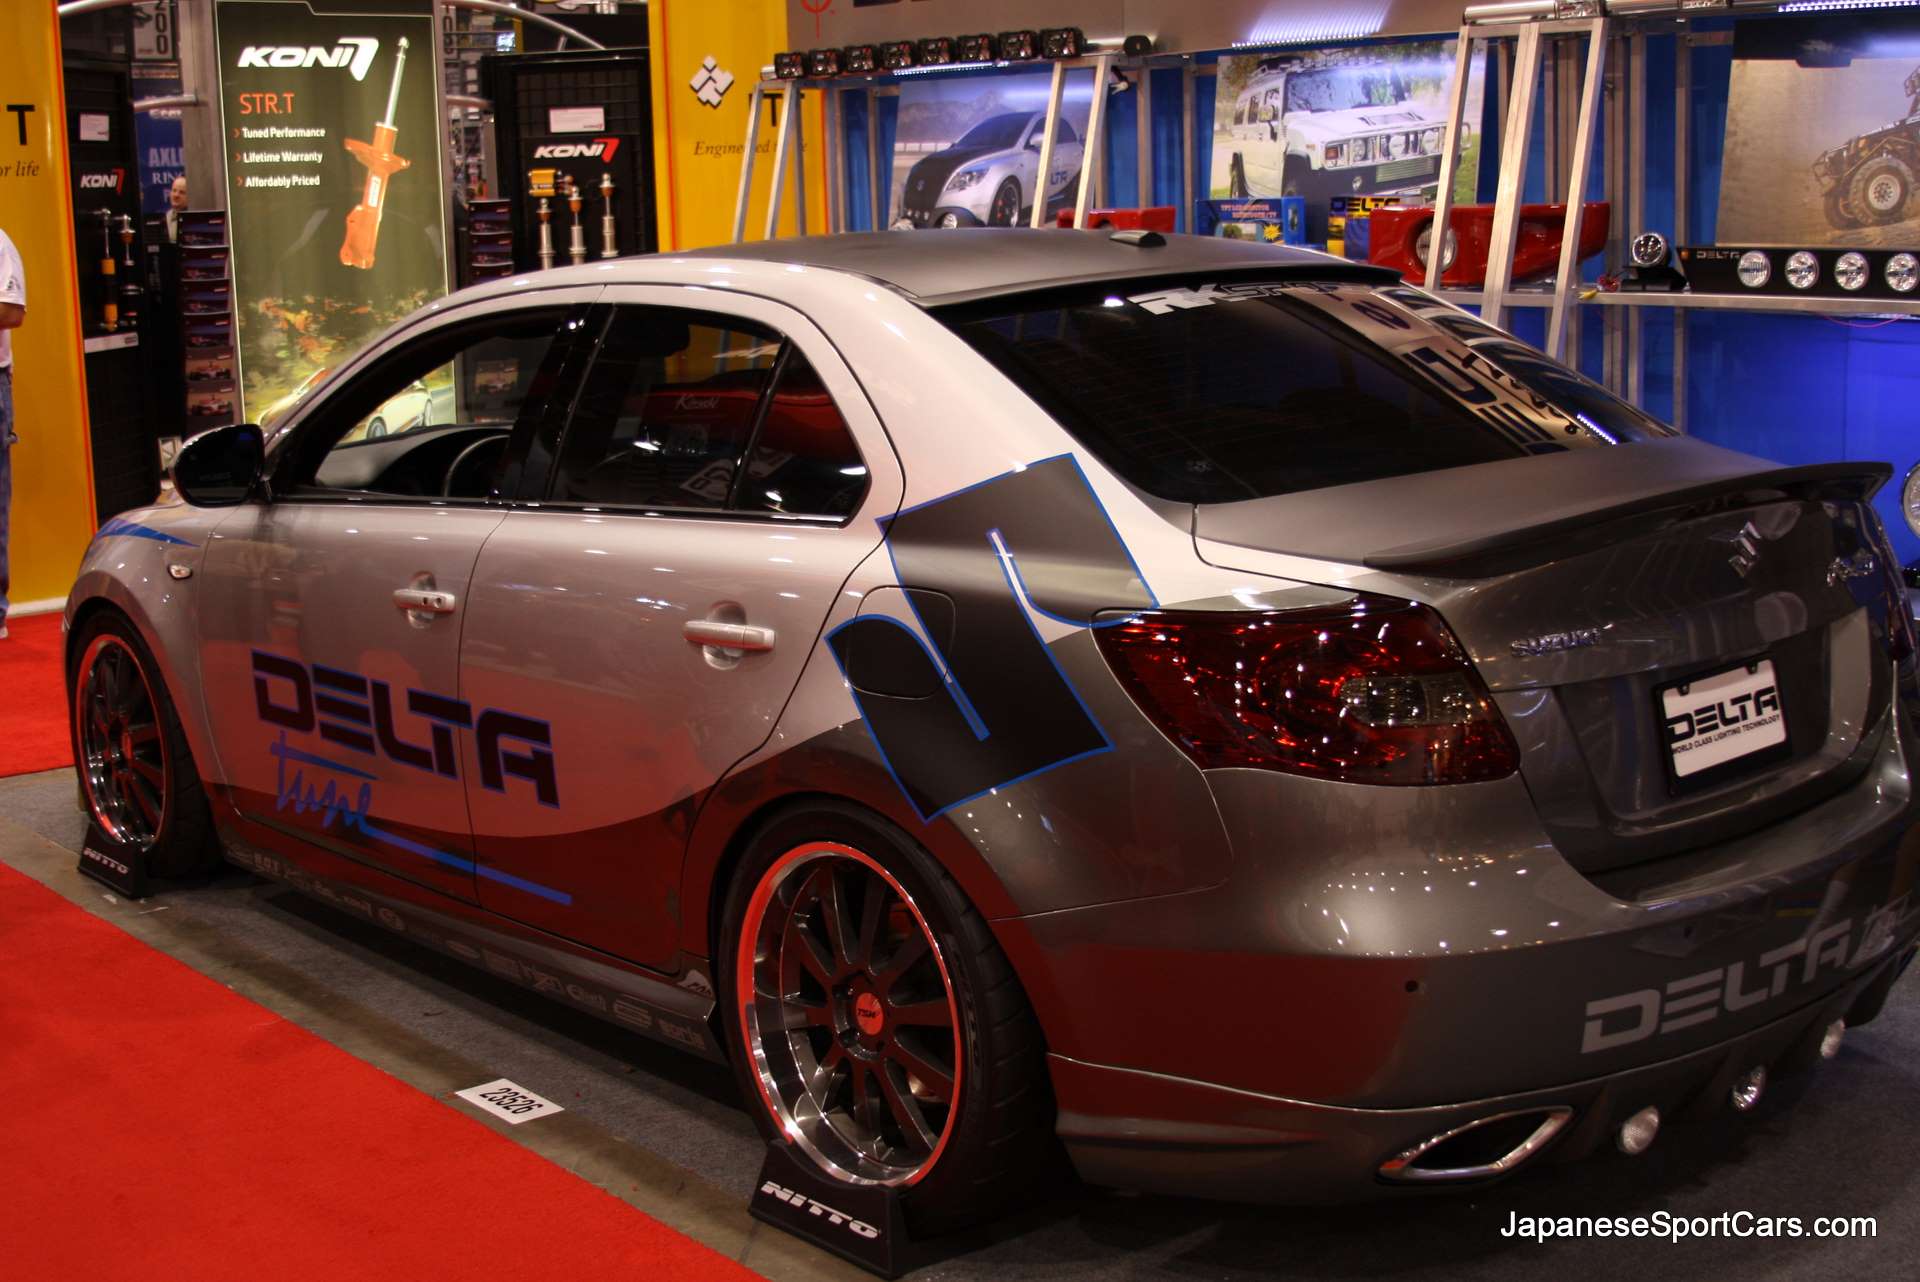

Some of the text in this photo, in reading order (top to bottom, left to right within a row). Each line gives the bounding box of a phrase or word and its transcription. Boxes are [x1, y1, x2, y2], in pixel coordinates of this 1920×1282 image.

[239, 92, 295, 114] STR.T
[242, 126, 326, 139] Tuned Performance
[243, 151, 323, 164] Lifetime Warranty
[533, 144, 605, 159] KONI
[15, 160, 40, 177] life
[80, 174, 118, 189] KONI
[244, 174, 320, 188] Affordably Priced
[1664, 685, 1779, 745] DELTA
[252, 649, 561, 810] DELTA
[1695, 735, 1713, 749] CLASS
[1714, 726, 1741, 742] LIGHTING
[1742, 714, 1780, 732] TECHNOLOGY
[1580, 917, 1851, 1054] DELTA
[479, 1087, 544, 1115] 23526
[760, 1180, 880, 1239] NITTO
